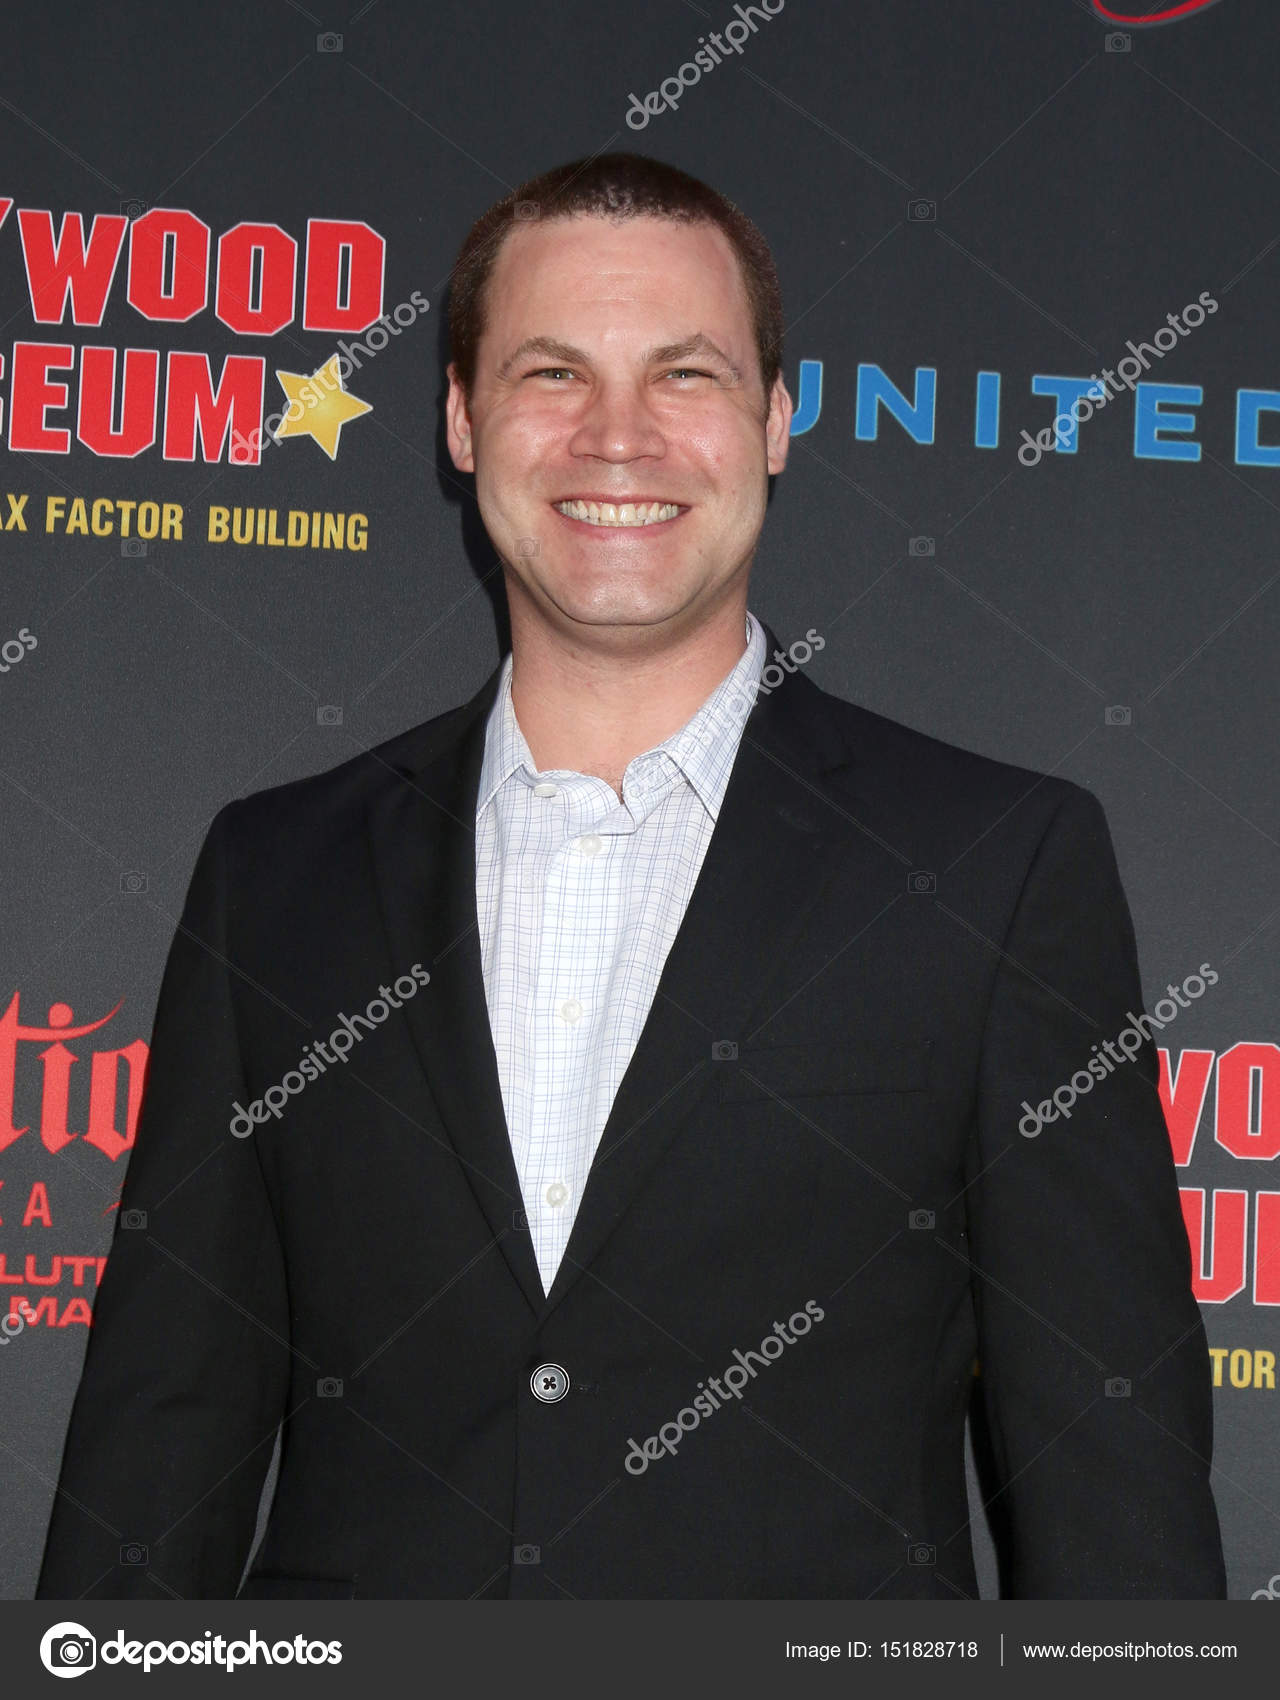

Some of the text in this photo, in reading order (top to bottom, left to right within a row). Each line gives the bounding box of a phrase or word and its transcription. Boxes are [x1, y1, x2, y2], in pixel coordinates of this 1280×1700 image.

[0, 197, 387, 337] WOOD
[0, 341, 267, 466] EUM
[0, 493, 369, 551] X FACTOR BUILDING
